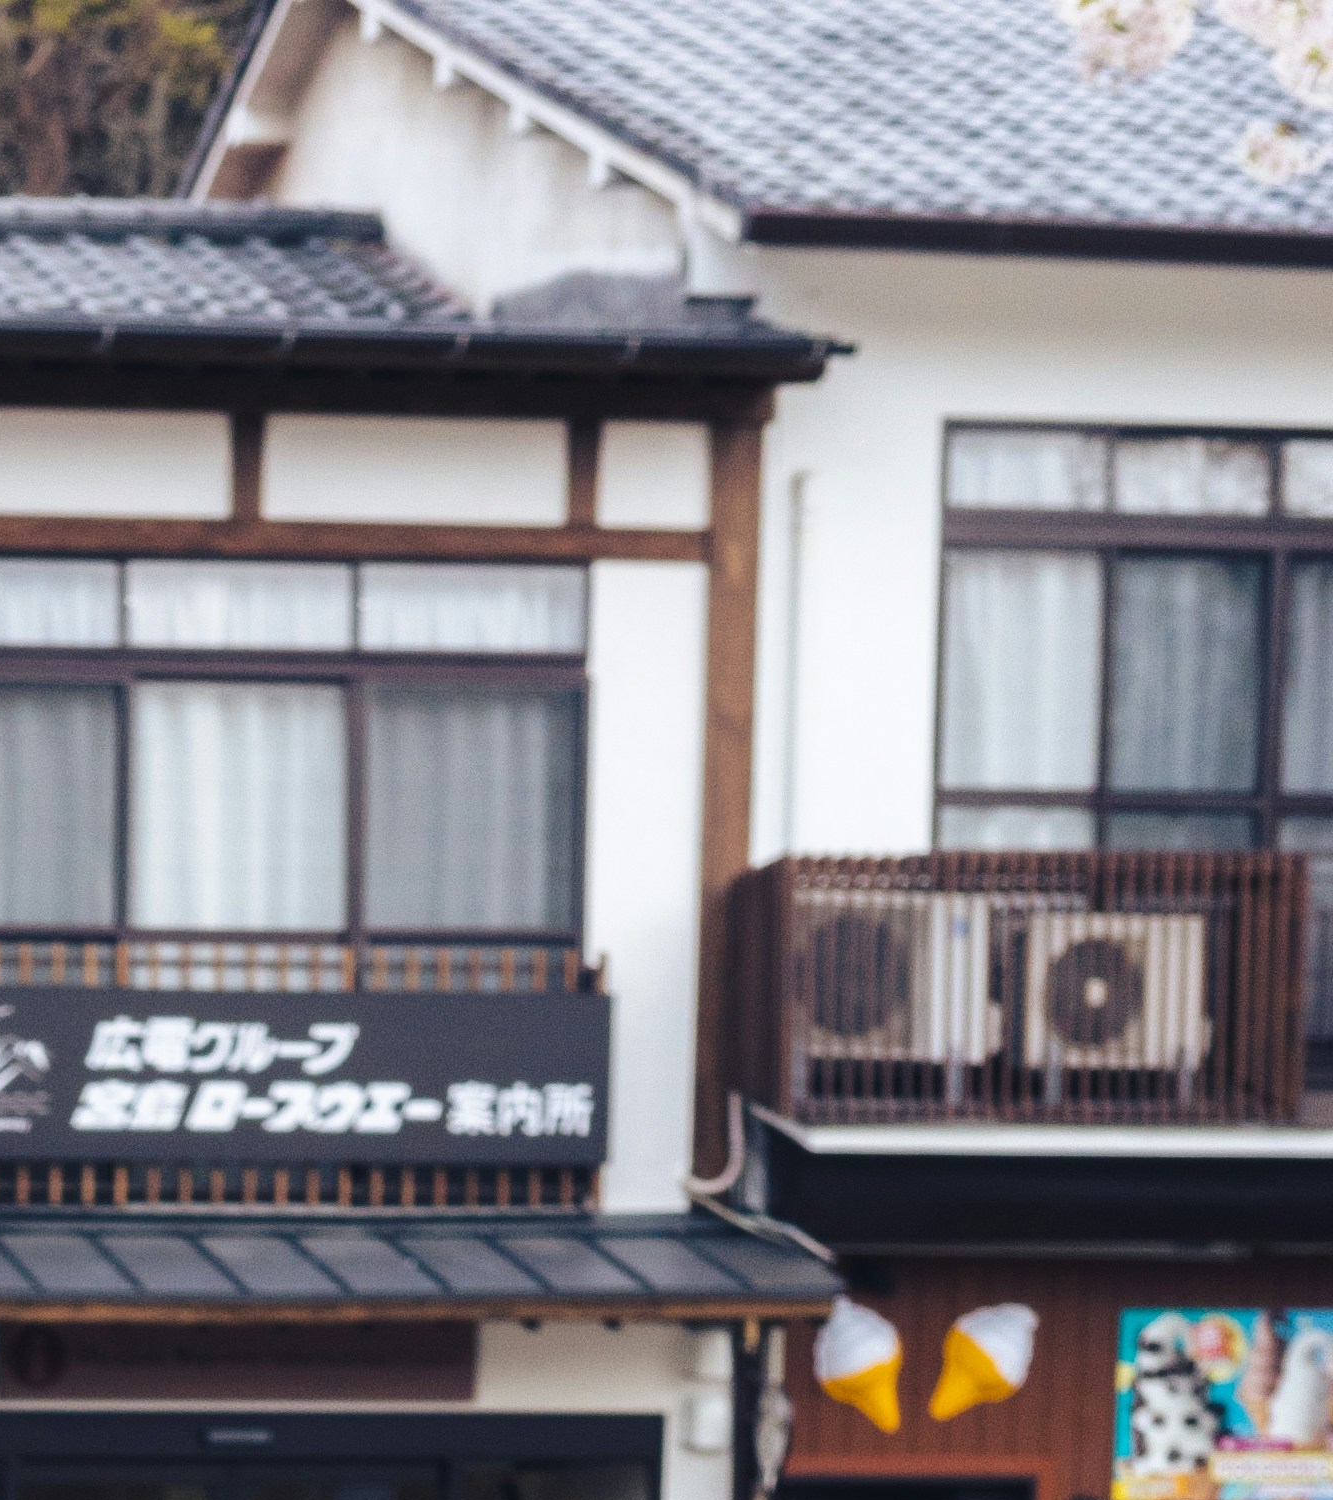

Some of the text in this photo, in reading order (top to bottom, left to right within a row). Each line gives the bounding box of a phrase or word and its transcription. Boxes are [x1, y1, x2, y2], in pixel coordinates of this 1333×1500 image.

[83, 1014, 361, 1076] 広電グループ
